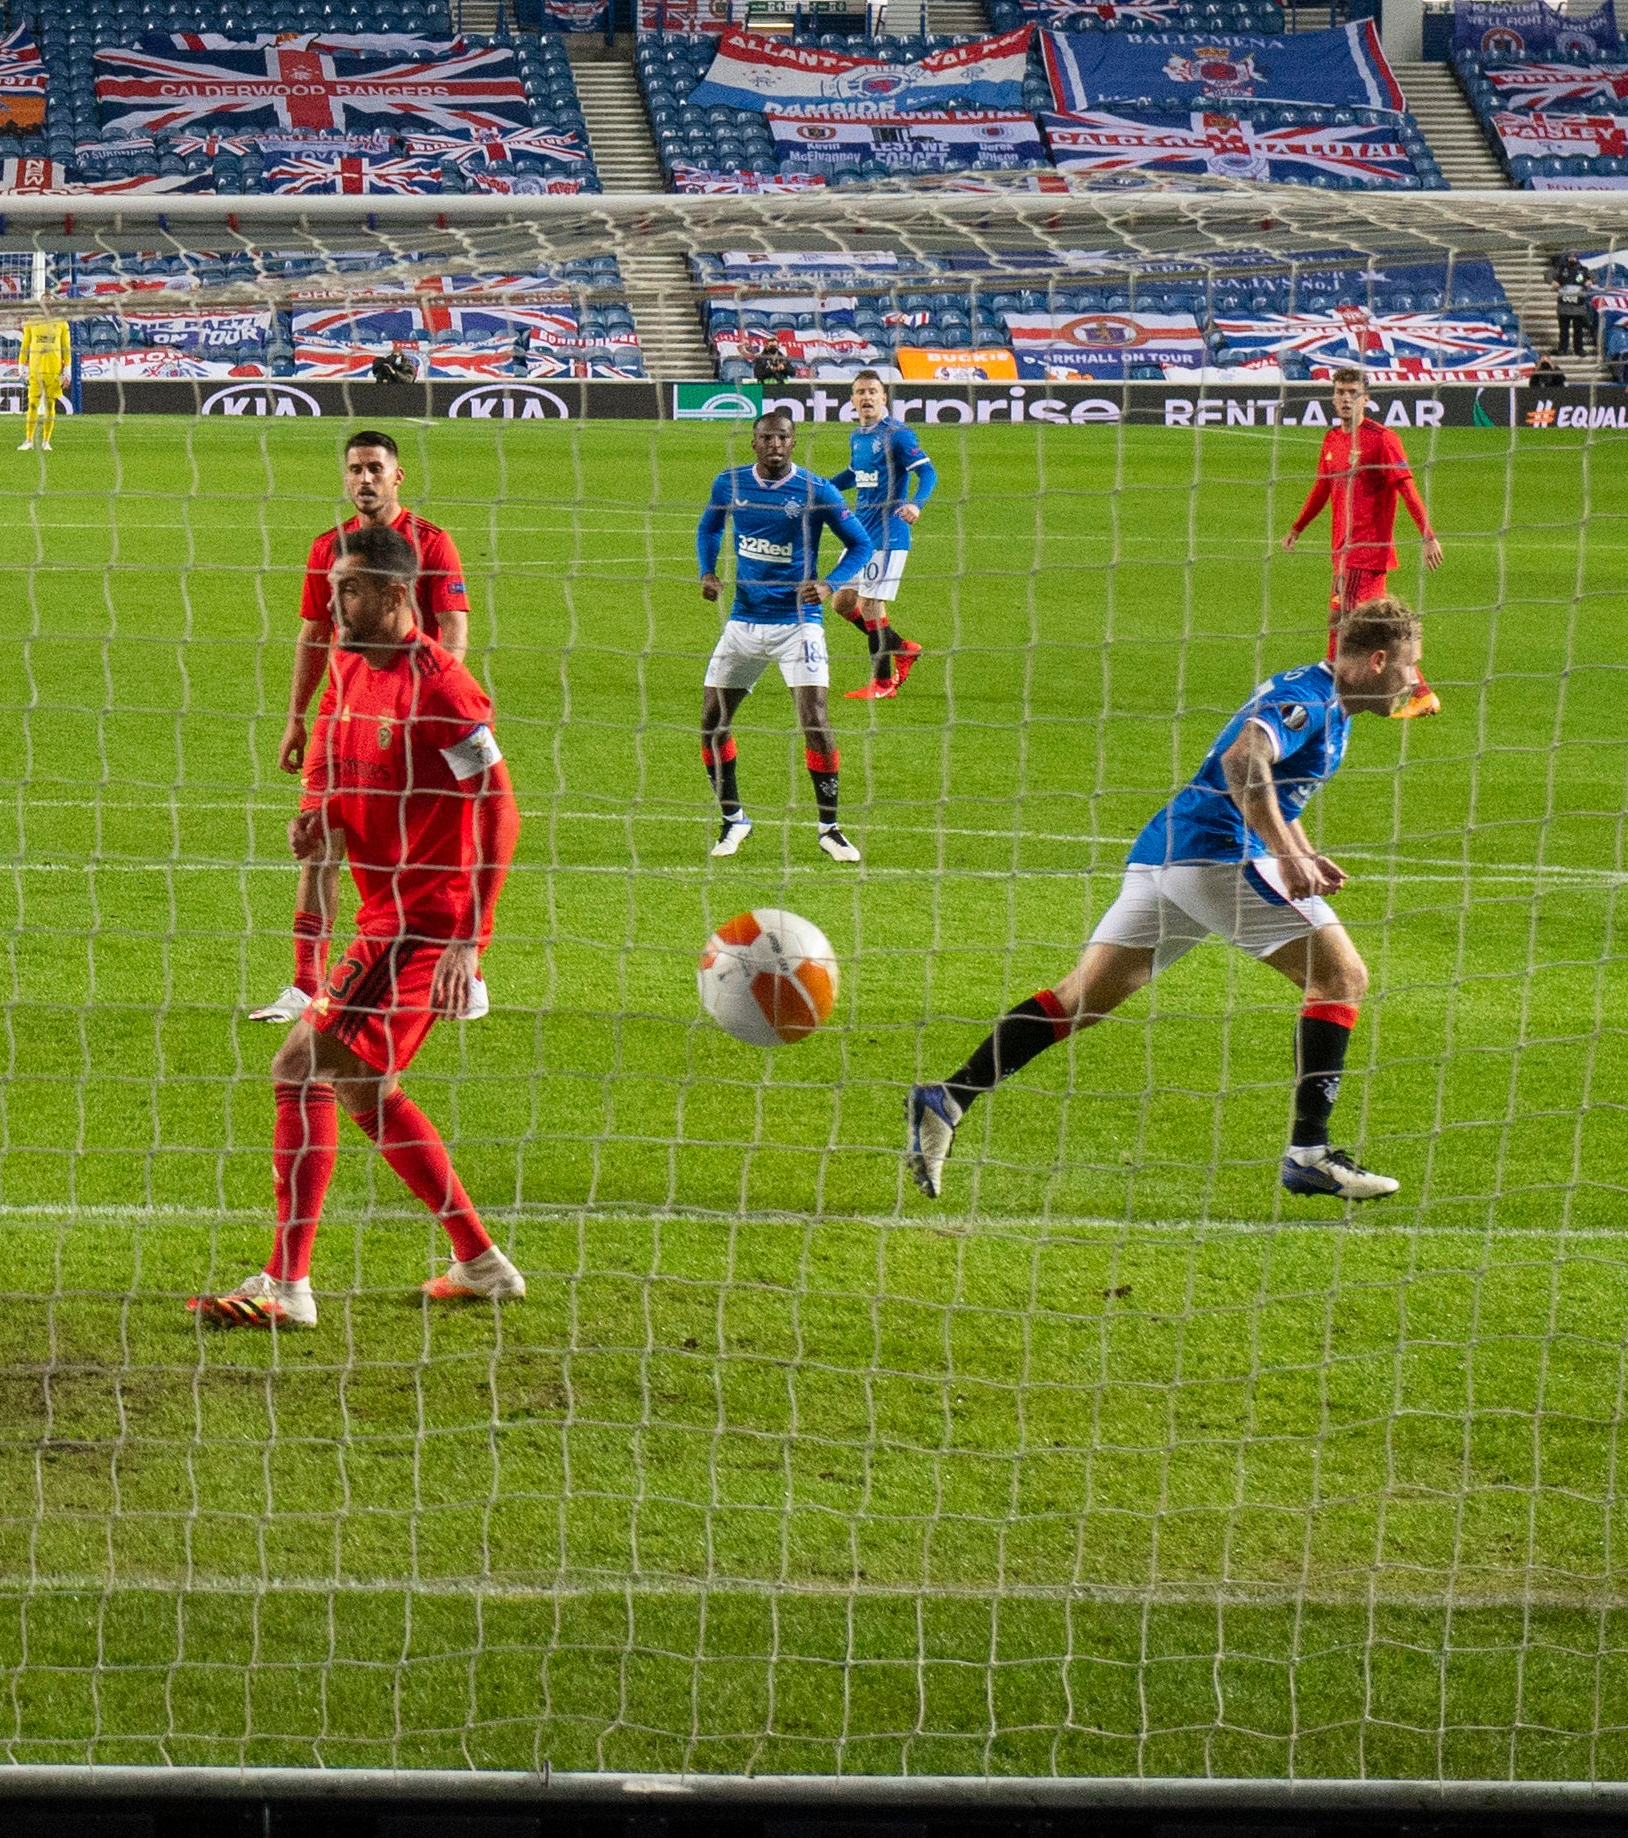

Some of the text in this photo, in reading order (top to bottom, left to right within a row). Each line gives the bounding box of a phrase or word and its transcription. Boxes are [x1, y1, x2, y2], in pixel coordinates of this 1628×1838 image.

[1506, 14, 1542, 27] FIGHT
[1127, 33, 1285, 49] BALLYMENA
[159, 84, 449, 97] CALDERWOOD RANGERS
[1505, 126, 1614, 140] PAISLEY
[870, 142, 951, 152] LEST WE
[1304, 143, 1407, 158] LOYAL
[1301, 277, 1341, 291] No.1
[152, 329, 255, 346] ON TOUR
[926, 352, 1011, 363] BUCKIE
[1120, 352, 1145, 363] ON
[1151, 352, 1195, 364] TOUR
[224, 396, 298, 418] KIA
[470, 397, 543, 419] KIA
[738, 534, 793, 556] 32Red
[803, 639, 822, 664] 18
